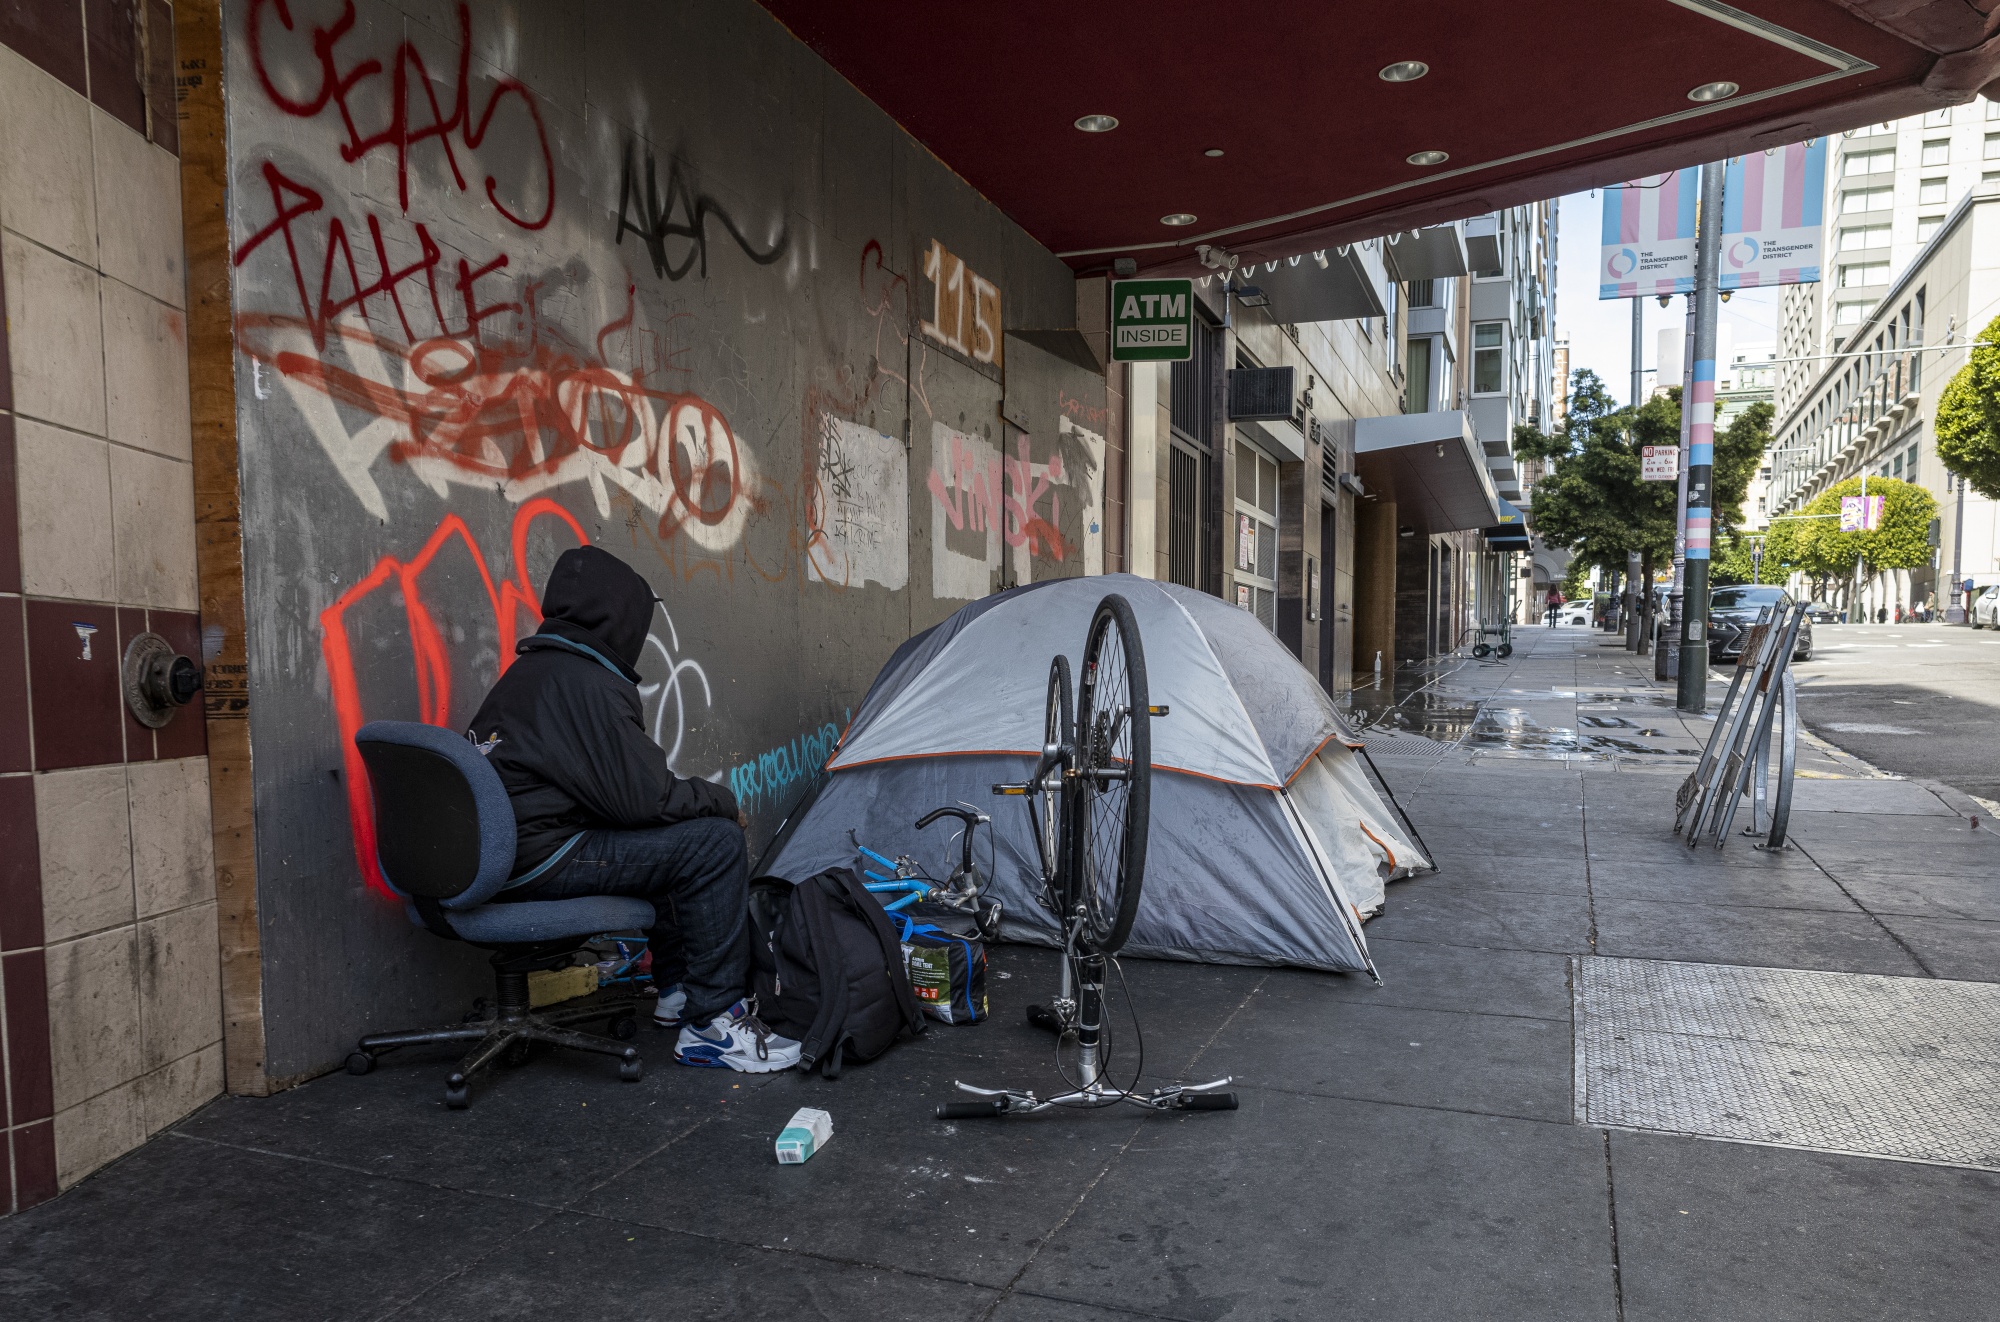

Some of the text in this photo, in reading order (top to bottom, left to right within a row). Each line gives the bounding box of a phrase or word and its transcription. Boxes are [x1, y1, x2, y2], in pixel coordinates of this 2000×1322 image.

[1763, 244, 1813, 253] TRANSGENDER
[1640, 255, 1688, 264] TRANSGENDER
[1762, 252, 1792, 260] DISTRICT
[921, 244, 996, 363] 115
[1120, 294, 1186, 319] ATM
[1121, 329, 1182, 343] INSIDE
[1643, 447, 1654, 457] NO
